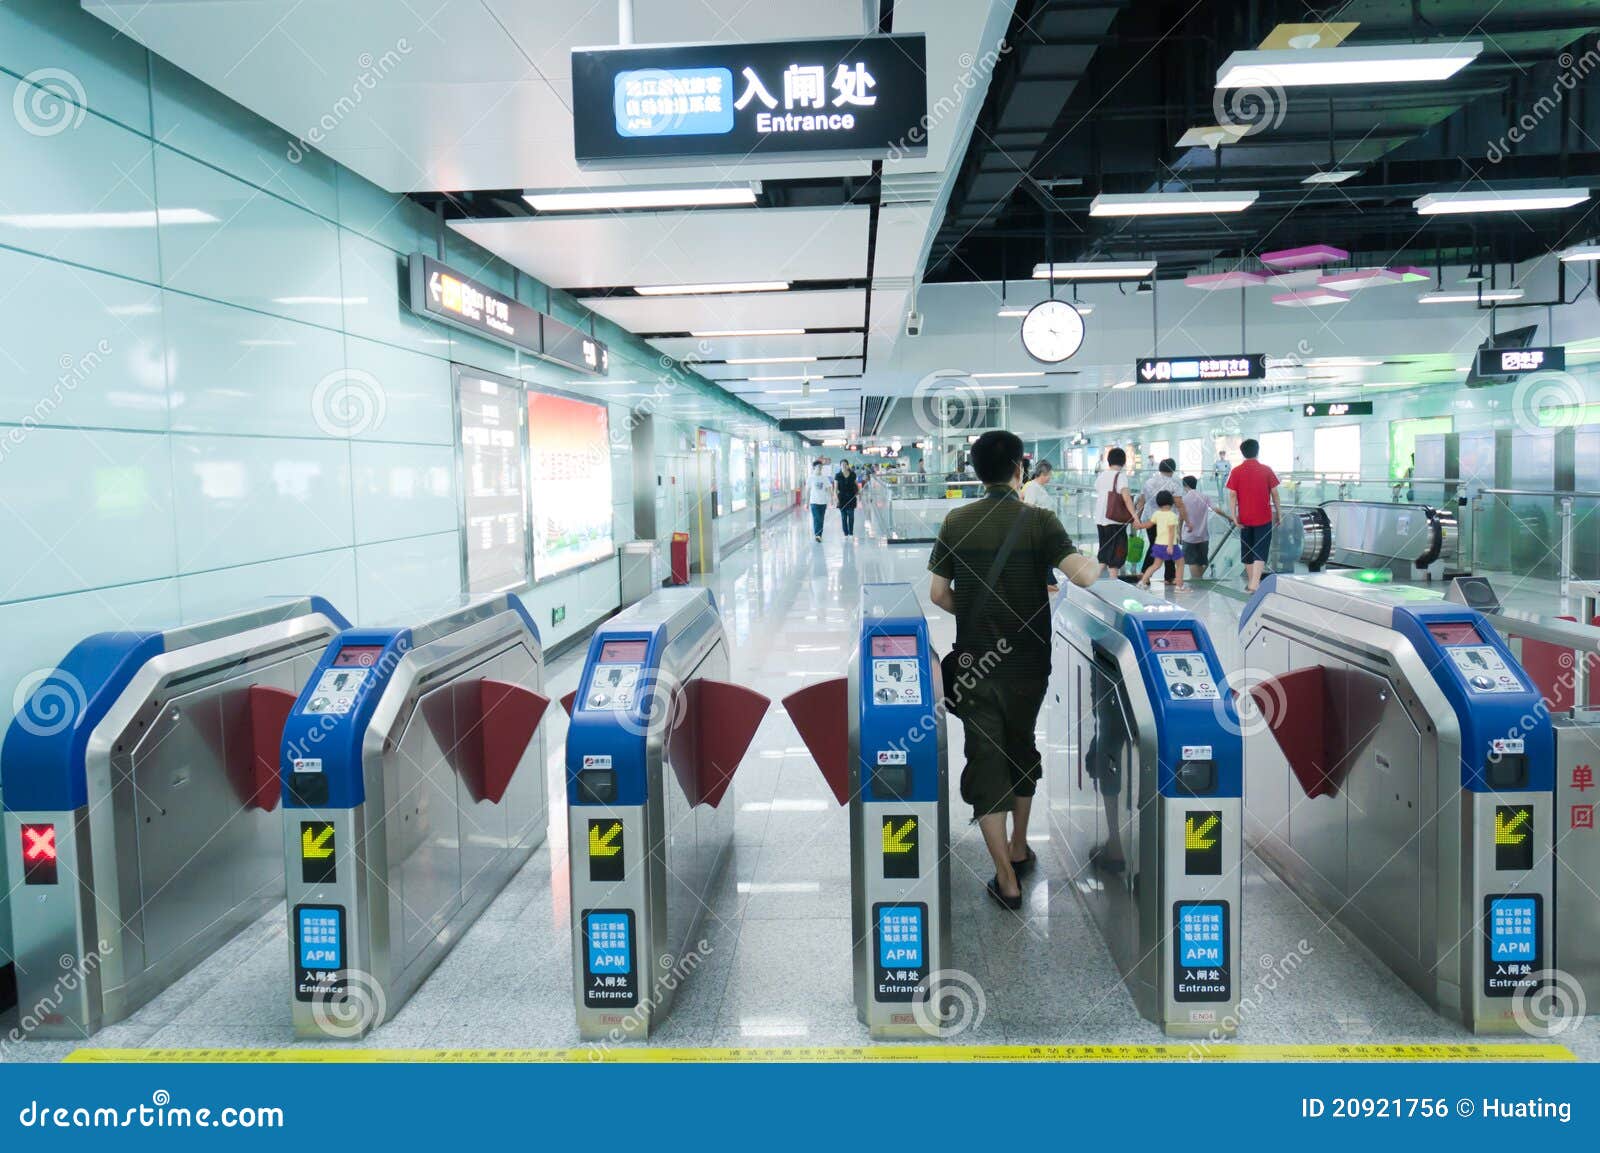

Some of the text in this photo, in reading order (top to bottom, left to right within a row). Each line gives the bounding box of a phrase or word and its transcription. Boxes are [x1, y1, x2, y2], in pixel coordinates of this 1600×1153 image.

[734, 62, 878, 110] 入闸处
[756, 112, 855, 133] Entrance
[1570, 764, 1595, 792] 单
[1571, 804, 1594, 829] 回
[1497, 942, 1530, 953] APM
[306, 950, 336, 961] APM
[886, 949, 917, 960] APM
[1186, 948, 1218, 959] APM
[594, 955, 625, 966] APM
[1185, 970, 1220, 980] 入闸处
[1495, 964, 1532, 975] 入闸处
[885, 970, 919, 981] 入闸处
[594, 976, 628, 987] 入闸处
[1489, 978, 1538, 987] Entrance
[299, 984, 343, 993] Entrance
[879, 984, 925, 993] Entrance
[1178, 984, 1226, 993] Entrance
[588, 990, 633, 999] Entrance
